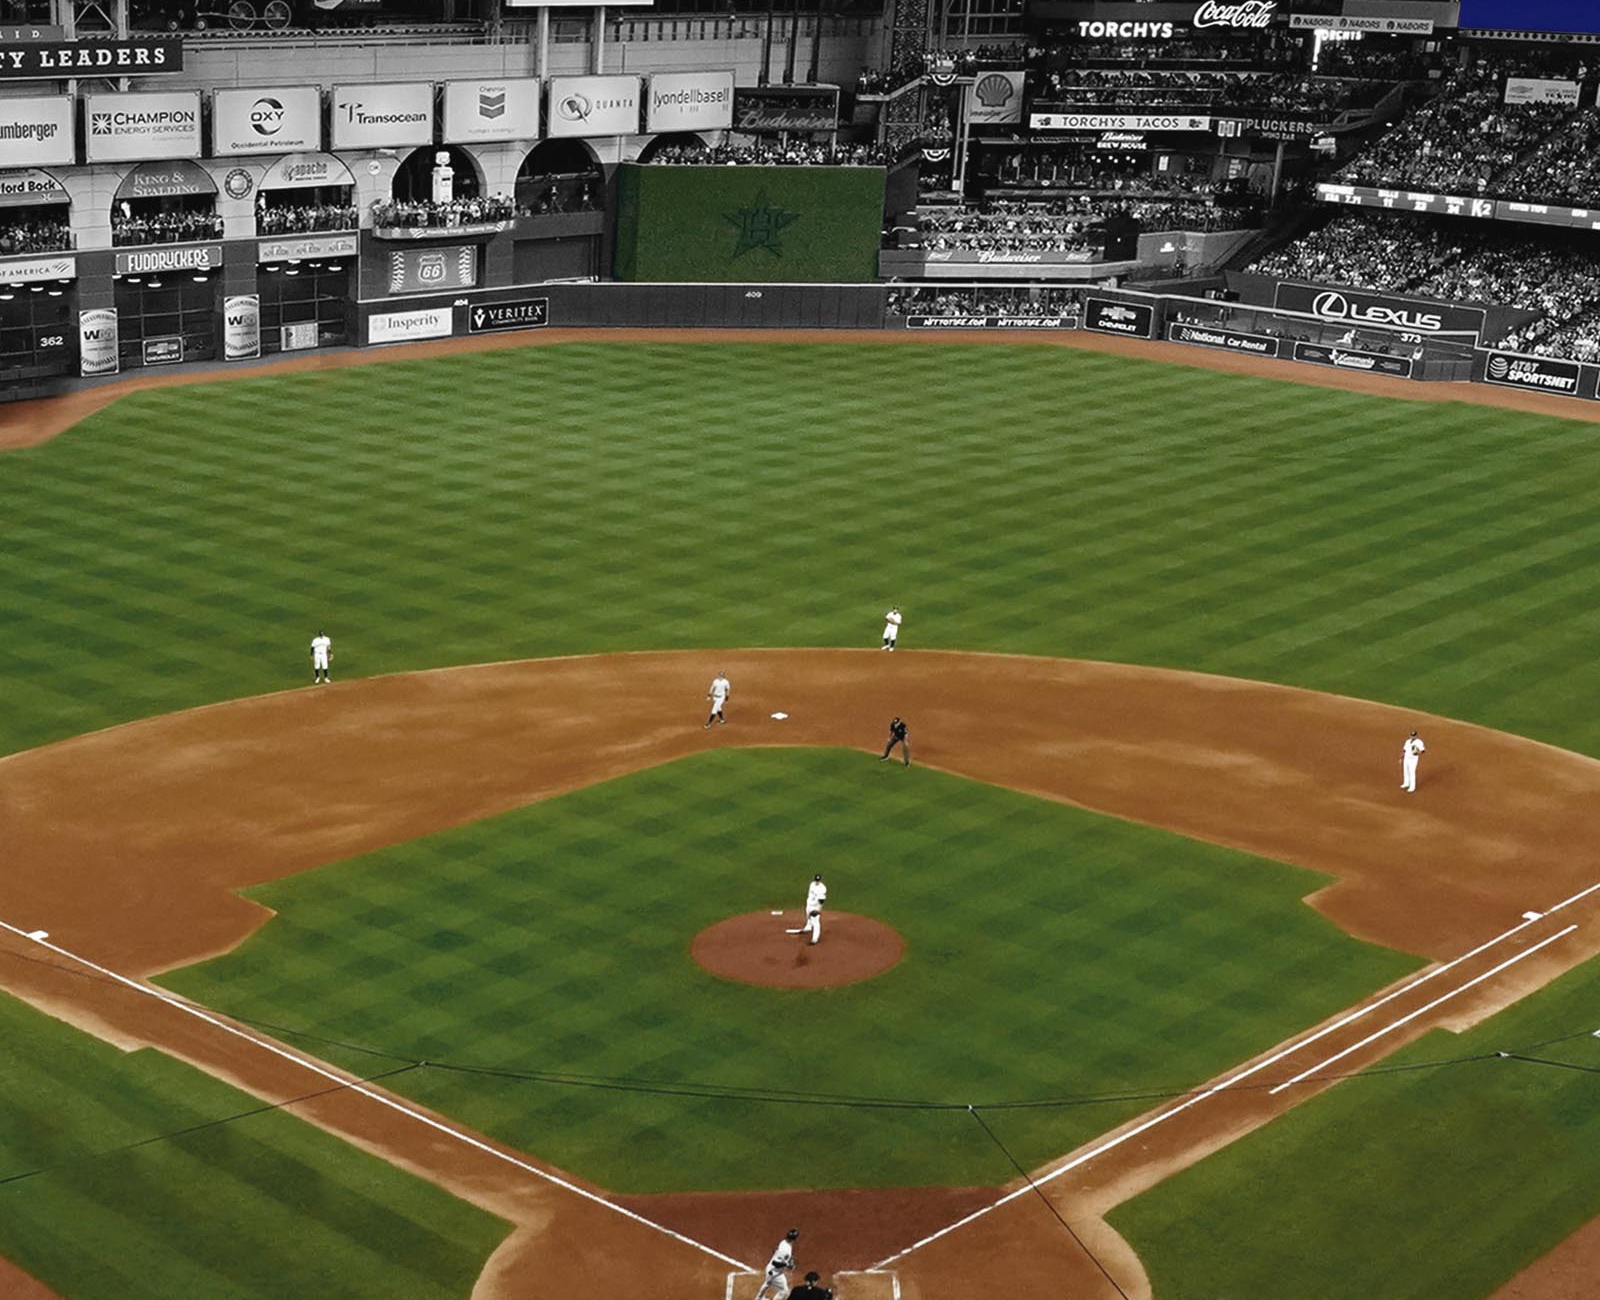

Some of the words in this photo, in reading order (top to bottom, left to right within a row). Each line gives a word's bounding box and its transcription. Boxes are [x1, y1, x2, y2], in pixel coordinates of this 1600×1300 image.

[1079, 22, 1173, 38] TORCHYS
[1303, 17, 1333, 28] NABORS
[1348, 19, 1380, 30] NABORS
[1396, 20, 1430, 32] NABORS
[40, 46, 166, 69] LEADERS
[654, 87, 729, 108] lyondellbasell
[114, 111, 195, 124] CHAMPION
[251, 110, 285, 121] OXY
[356, 110, 427, 125] Transocean
[740, 108, 838, 129] Budweiser
[114, 127, 150, 135] ENERGY
[152, 125, 195, 133] SERVICES
[1062, 117, 1125, 128] TORCHYS
[1136, 117, 1179, 129] TACOS
[1247, 119, 1314, 134] PLUCKERS
[231, 140, 267, 149] Occidental
[269, 138, 304, 147] Petroleum
[134, 173, 168, 185] KING
[171, 172, 184, 182] &
[28, 180, 56, 192] Bock
[133, 184, 200, 197] SPALDING
[128, 249, 209, 272] FUDDRUCKERS
[977, 250, 1041, 263] Budweiser
[9, 267, 50, 276] AMERICA
[422, 265, 440, 278] 66
[489, 305, 543, 319] VERITEX
[1349, 304, 1442, 331] LEXUS
[388, 313, 440, 330] Insperity
[40, 335, 63, 347] 362
[1191, 330, 1225, 344] National
[1228, 338, 1241, 347] Car
[1242, 339, 1266, 351] Rental
[1401, 332, 1421, 344] 373
[1510, 360, 1539, 374] AT&T
[1508, 369, 1574, 390] SPORTSNET
